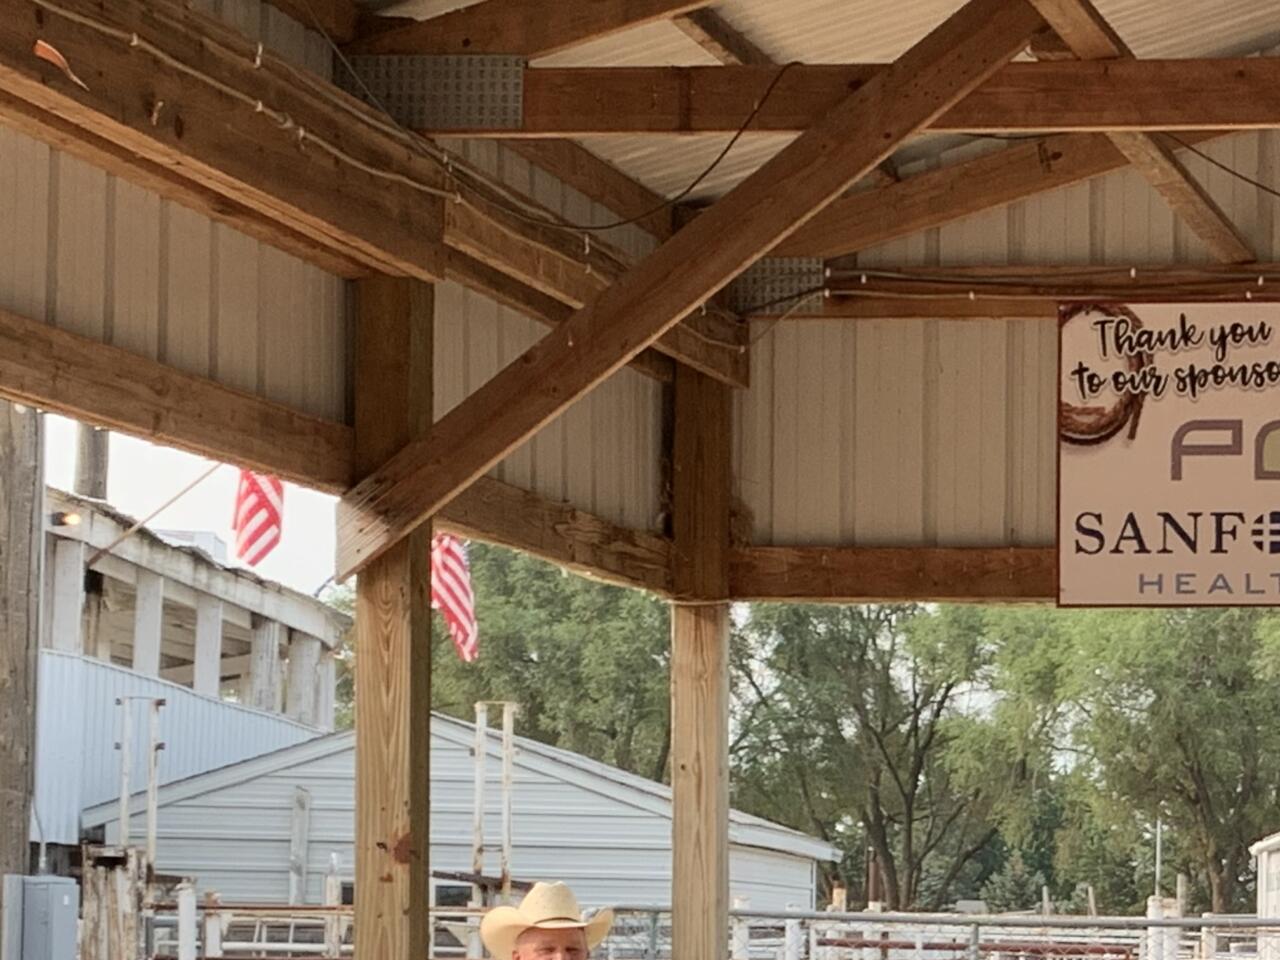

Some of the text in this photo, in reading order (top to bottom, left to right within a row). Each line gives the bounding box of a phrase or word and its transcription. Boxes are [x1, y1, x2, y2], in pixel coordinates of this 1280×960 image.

[1094, 313, 1273, 361] Thank you
[1071, 361, 1105, 399] to
[1112, 364, 1168, 397] our
